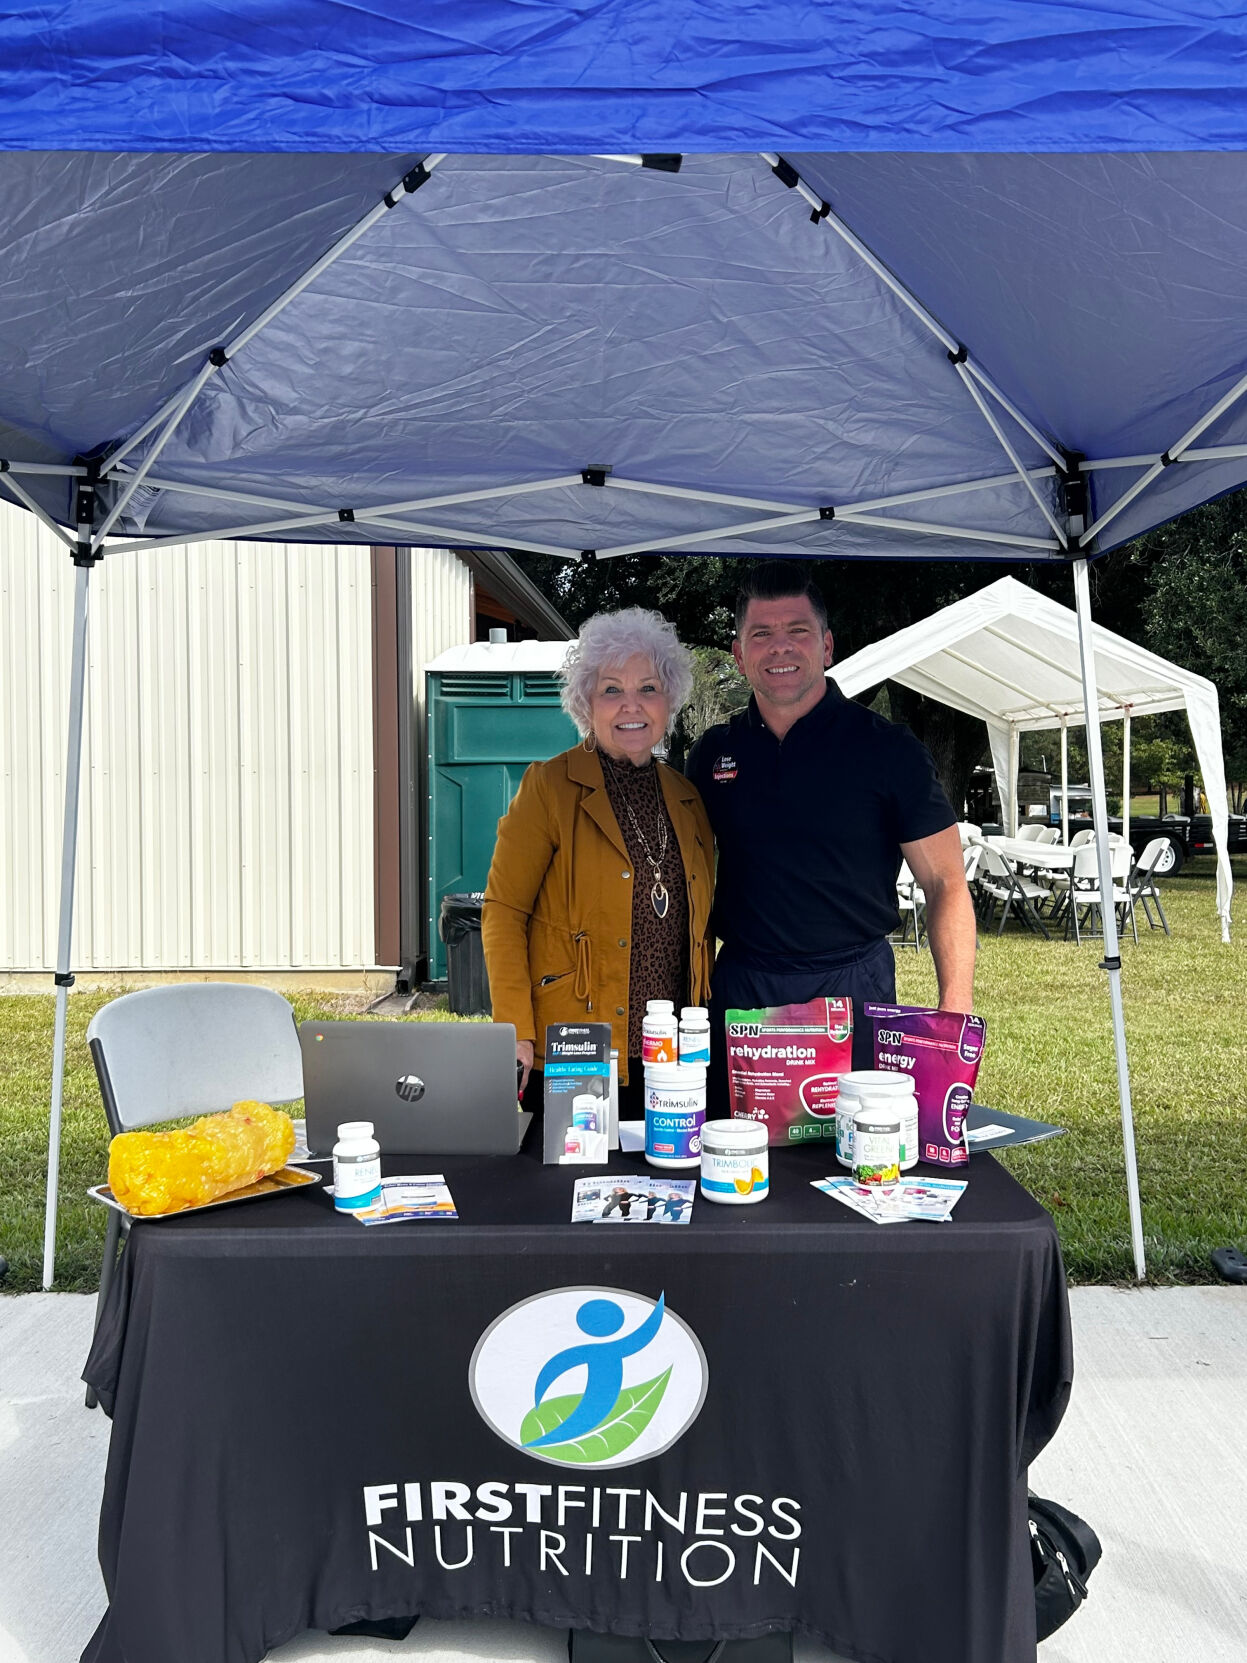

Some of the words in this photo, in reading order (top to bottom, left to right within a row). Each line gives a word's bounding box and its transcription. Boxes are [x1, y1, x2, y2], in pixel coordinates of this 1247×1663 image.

[831, 1000, 844, 1008] 14
[730, 1024, 760, 1036] SPN
[879, 1030, 904, 1045] SPN
[551, 1041, 597, 1052] Trimsulin
[730, 1044, 816, 1060] rehydration
[879, 1052, 917, 1070] energy
[363, 1481, 802, 1540] FIRSTFITNESS
[368, 1525, 801, 1587] NUTRITION
